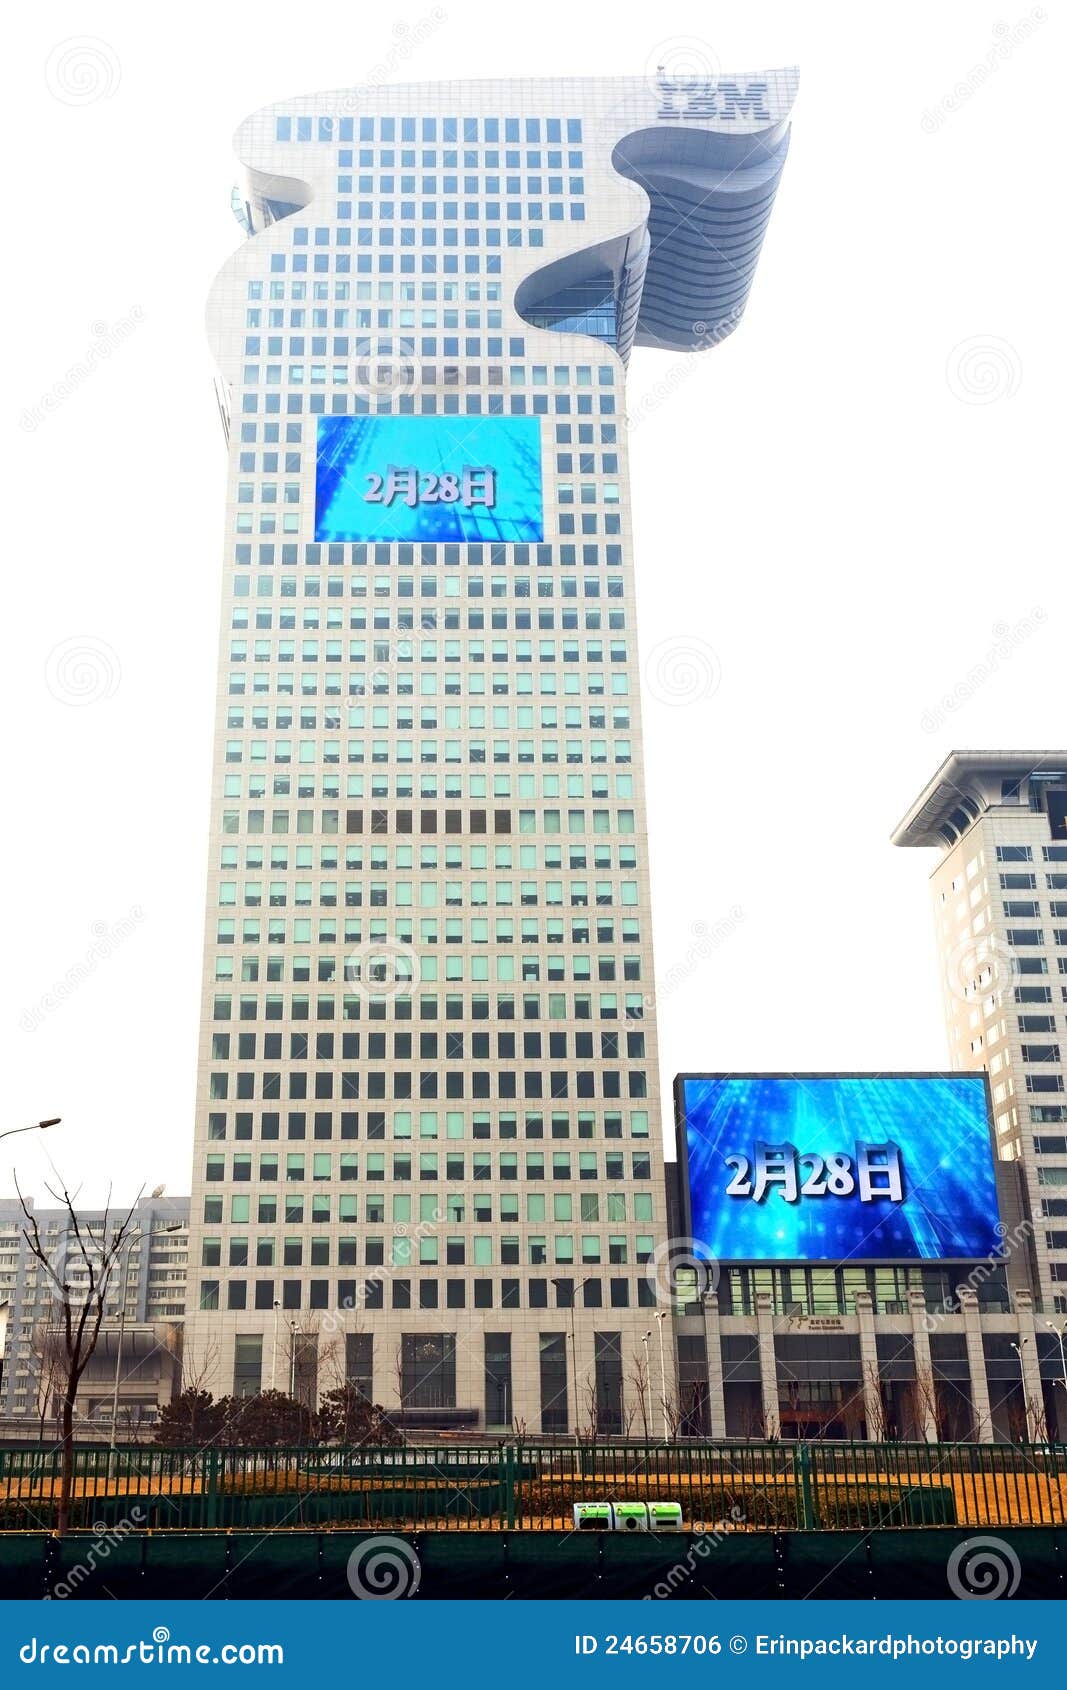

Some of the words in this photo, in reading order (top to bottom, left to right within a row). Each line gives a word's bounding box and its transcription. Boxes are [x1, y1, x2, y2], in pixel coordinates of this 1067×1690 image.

[657, 82, 770, 120] IBM
[364, 463, 498, 508] 2月28日
[724, 1138, 904, 1203] 2月28日
